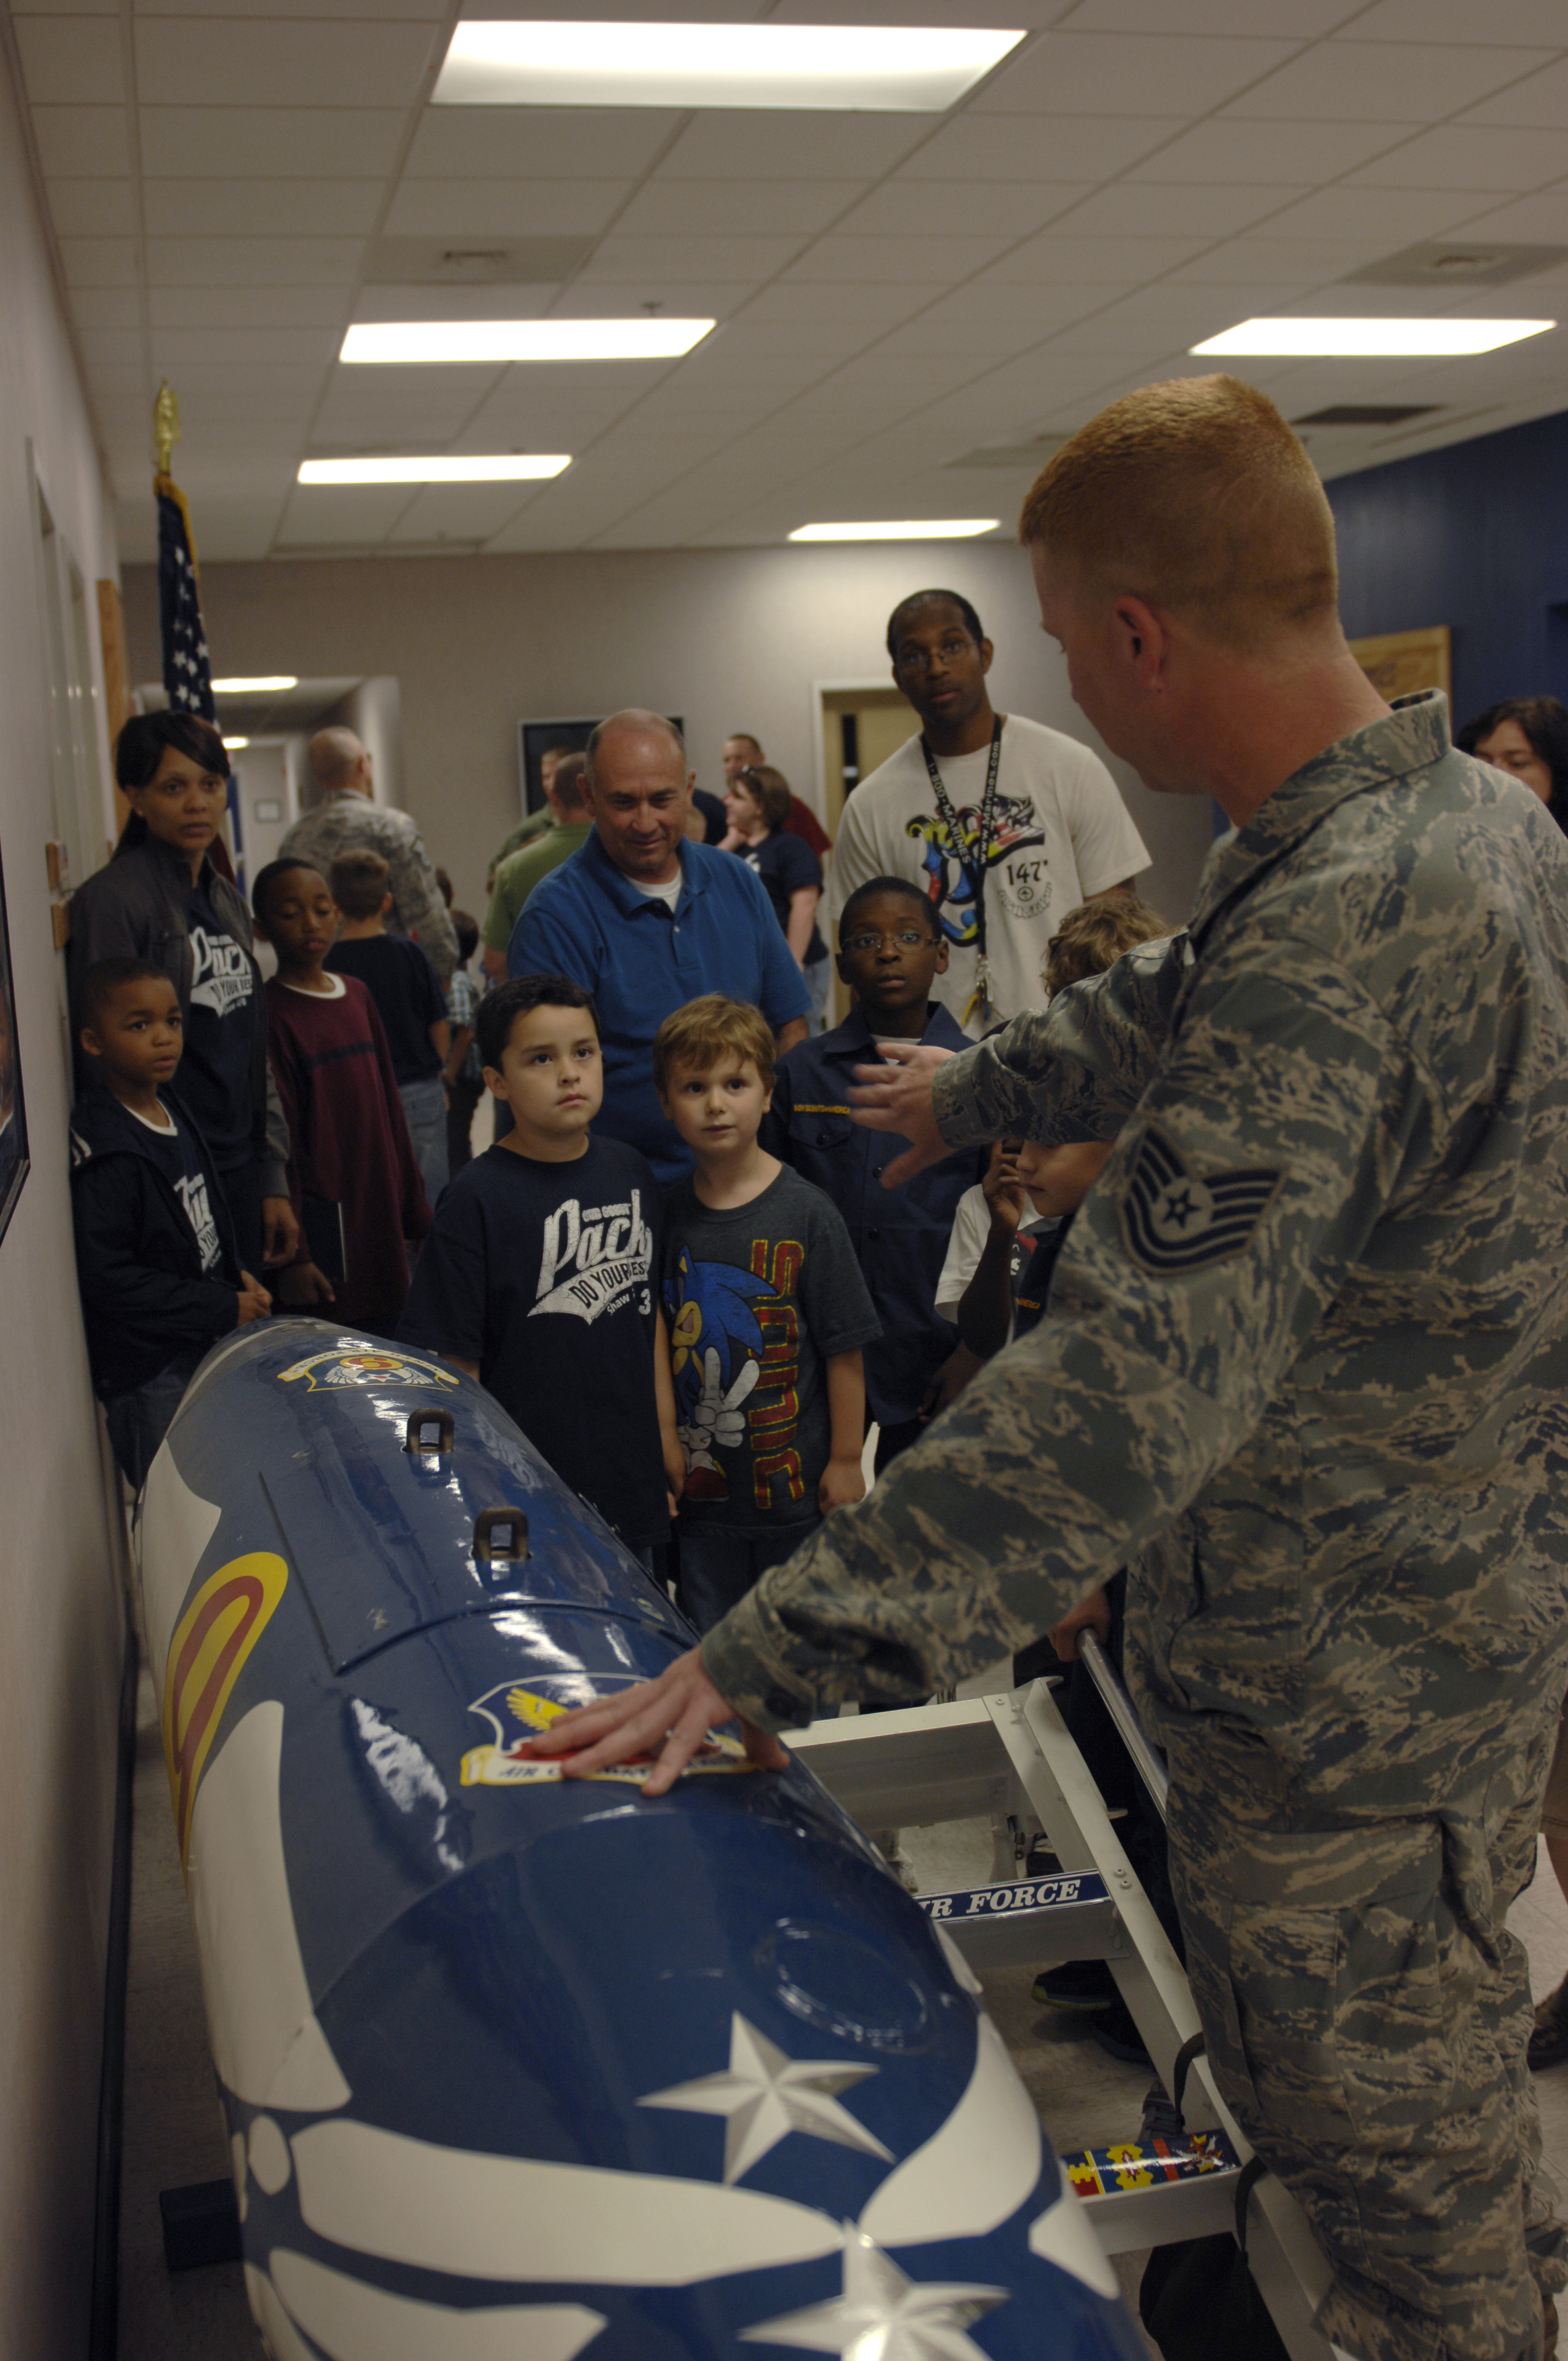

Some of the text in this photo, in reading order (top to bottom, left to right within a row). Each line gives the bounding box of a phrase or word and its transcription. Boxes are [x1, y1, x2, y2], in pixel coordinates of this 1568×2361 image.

[569, 1280, 599, 1310] DO
[748, 1239, 805, 1509] SONIC
[918, 1879, 1081, 1918] IR FORCE
